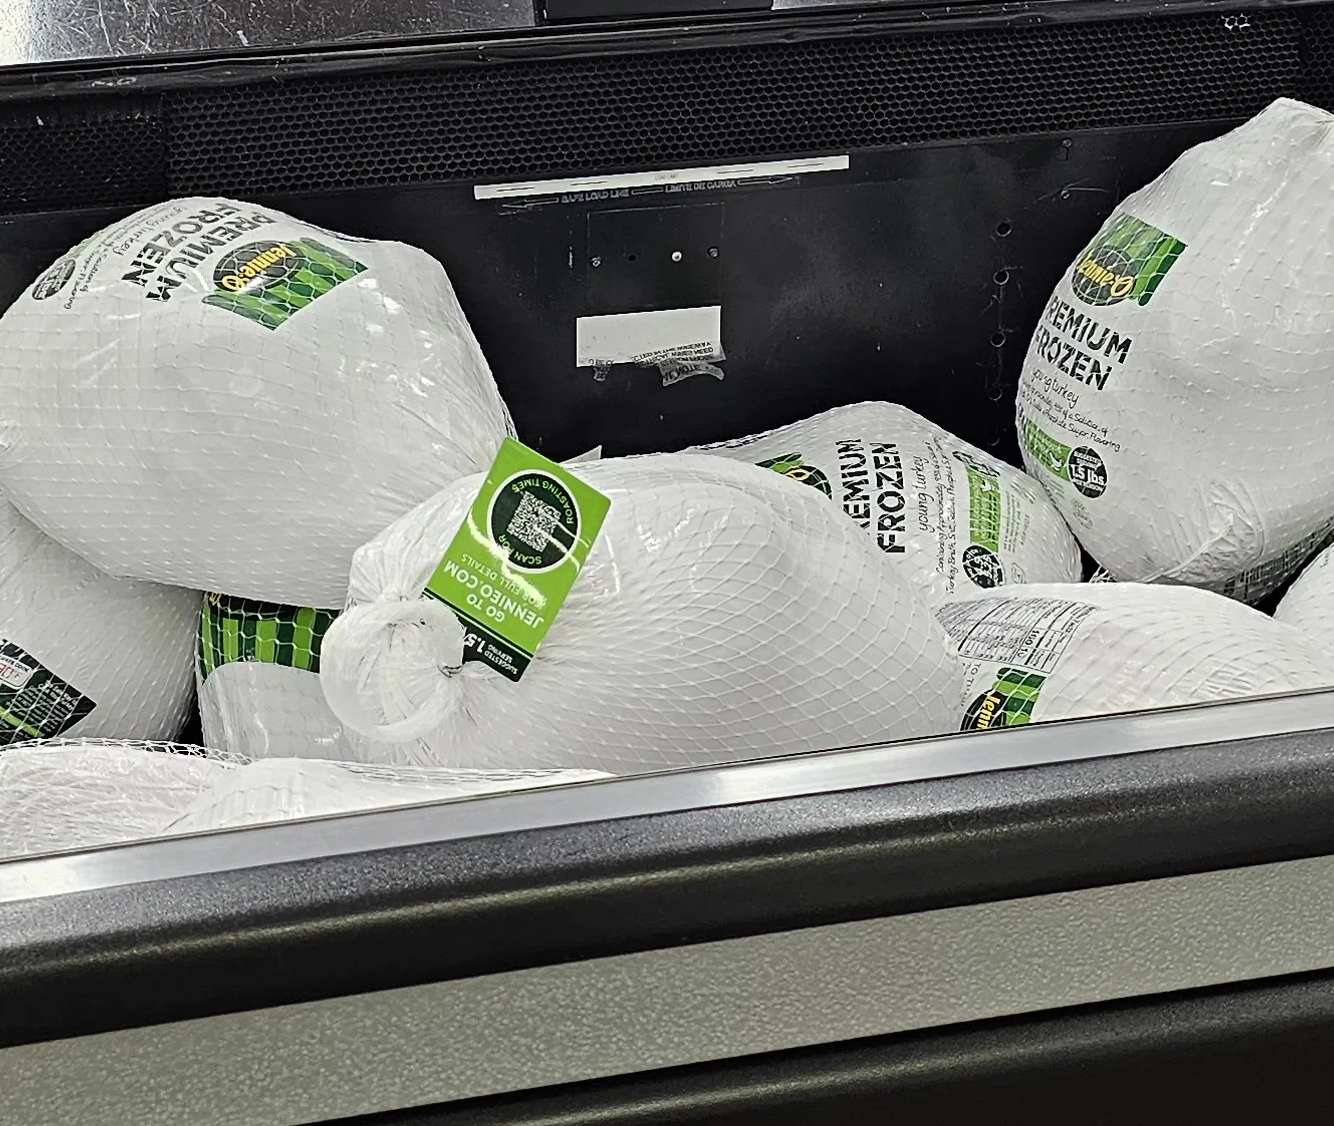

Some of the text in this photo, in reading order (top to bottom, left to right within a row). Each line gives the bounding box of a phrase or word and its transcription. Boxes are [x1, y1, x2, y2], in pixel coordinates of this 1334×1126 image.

[113, 222, 152, 257] turkey
[121, 202, 242, 287] FROZEN
[145, 211, 278, 303] PREMIUM
[1045, 295, 1133, 364] REMIUM
[1051, 379, 1080, 410] turkey
[511, 478, 575, 524] ROASTING TIMES
[836, 438, 871, 529] EMIUM
[870, 442, 906, 554] FROZEN
[910, 455, 935, 533] young turkey
[460, 553, 499, 582] DETAILS
[514, 550, 542, 566] SCAN
[443, 560, 544, 630] JENNIEO.COM
[466, 593, 505, 623] GO TO
[977, 695, 1002, 731] Jenn
